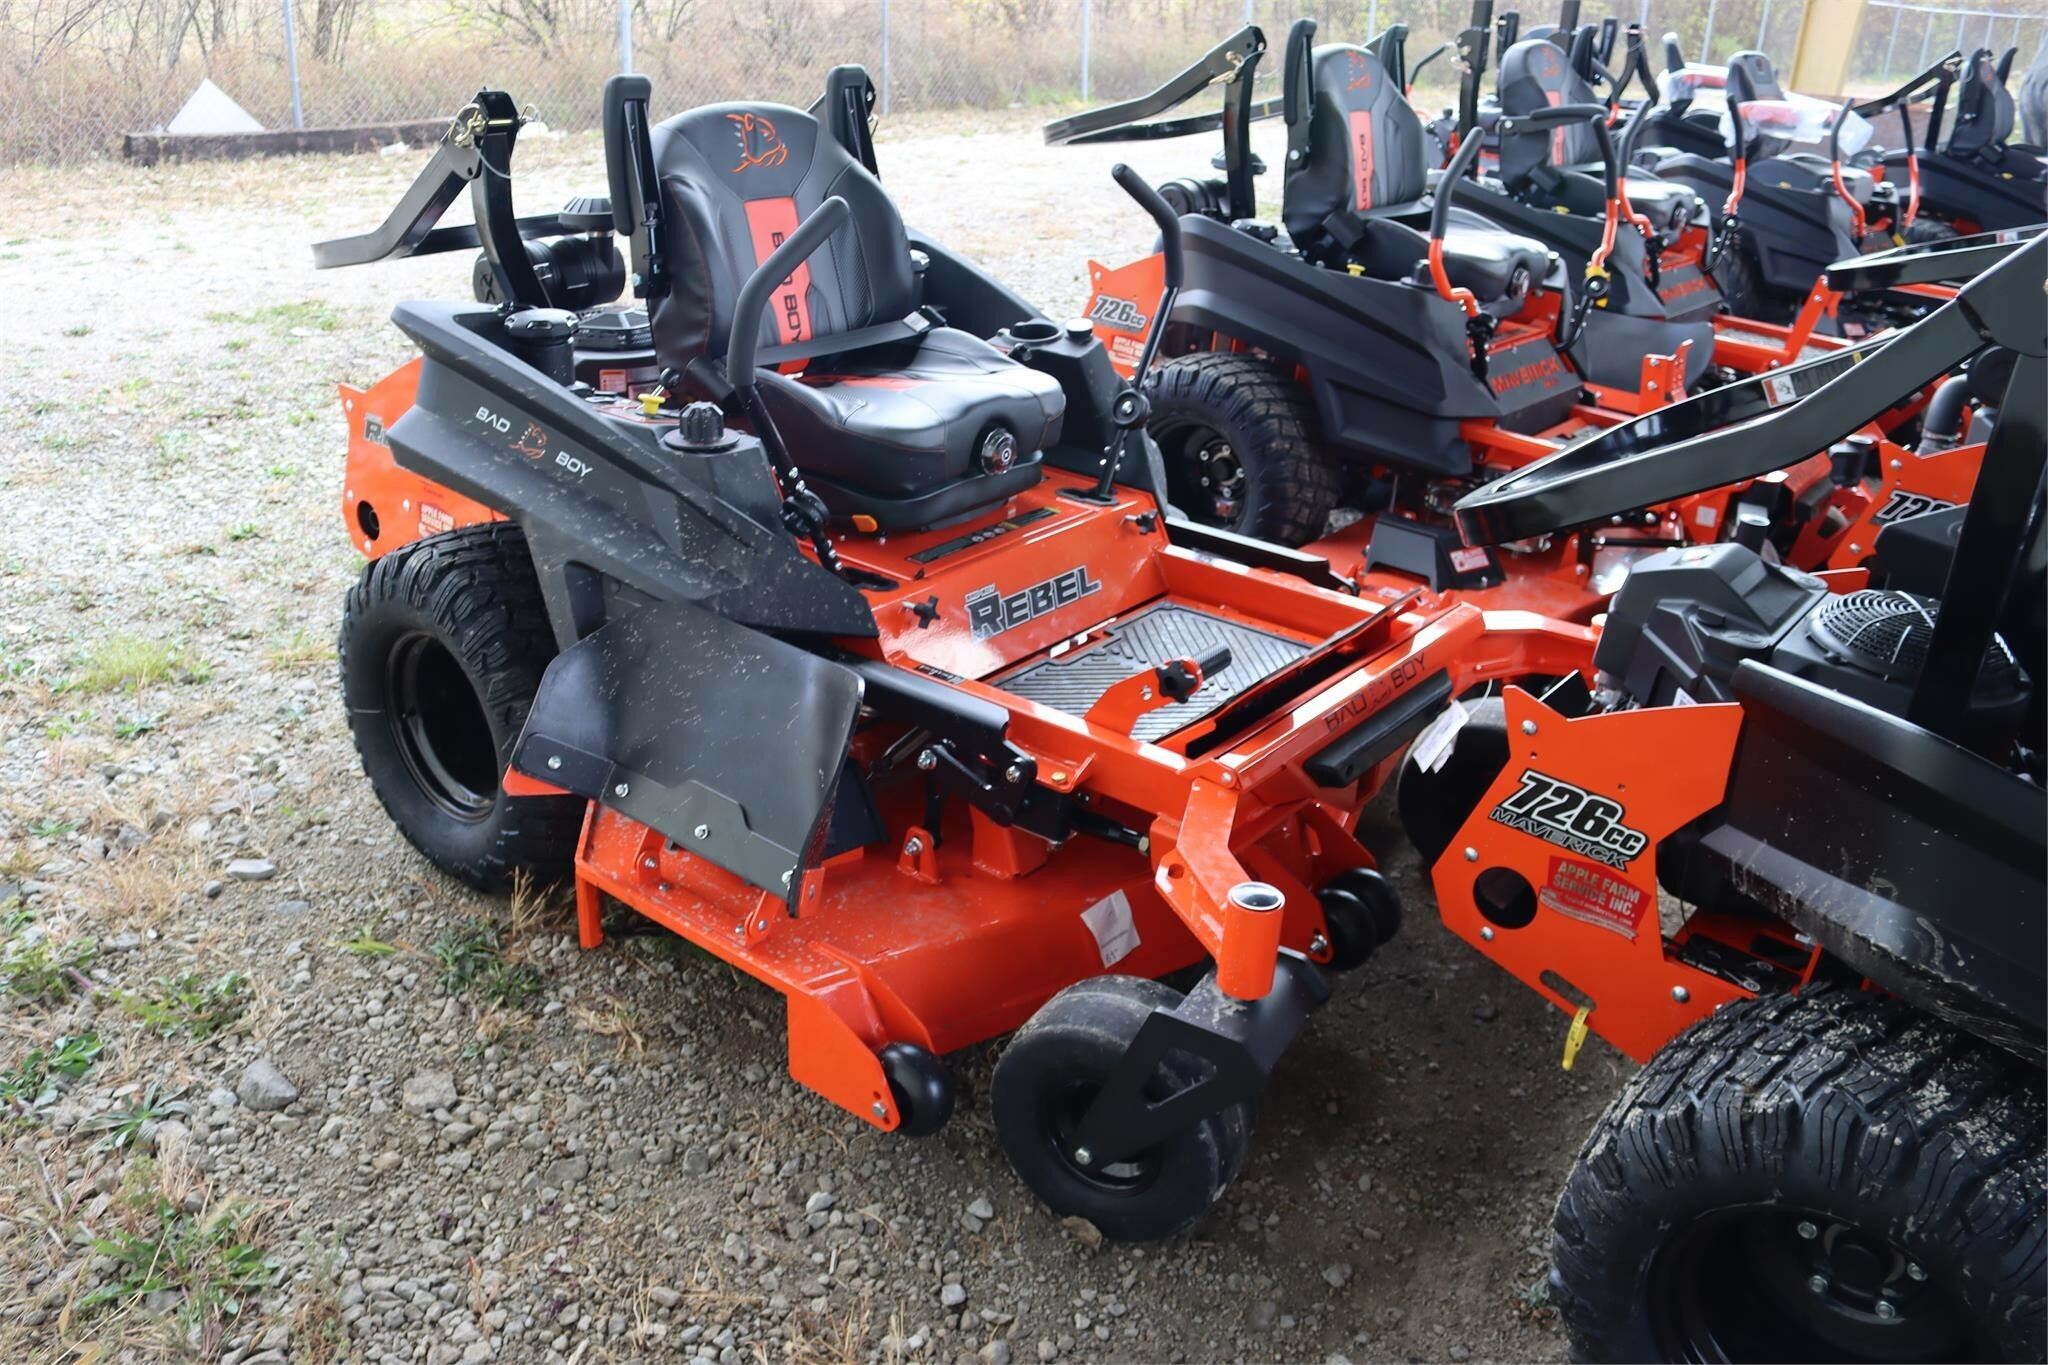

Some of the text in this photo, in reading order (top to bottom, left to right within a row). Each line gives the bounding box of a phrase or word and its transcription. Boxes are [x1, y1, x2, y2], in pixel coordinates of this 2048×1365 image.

[1090, 294, 1147, 329] 726cc
[475, 406, 594, 477] BAD BOY
[965, 565, 1102, 644] REBEL
[1323, 652, 1425, 732] BAD BOY
[1490, 807, 1630, 870] MAVERICK
[1500, 769, 1647, 856] 726cc
[1553, 874, 1606, 905] SERVICE
[1609, 896, 1635, 918] INC.
[1558, 861, 1640, 904] APPLE FARM
